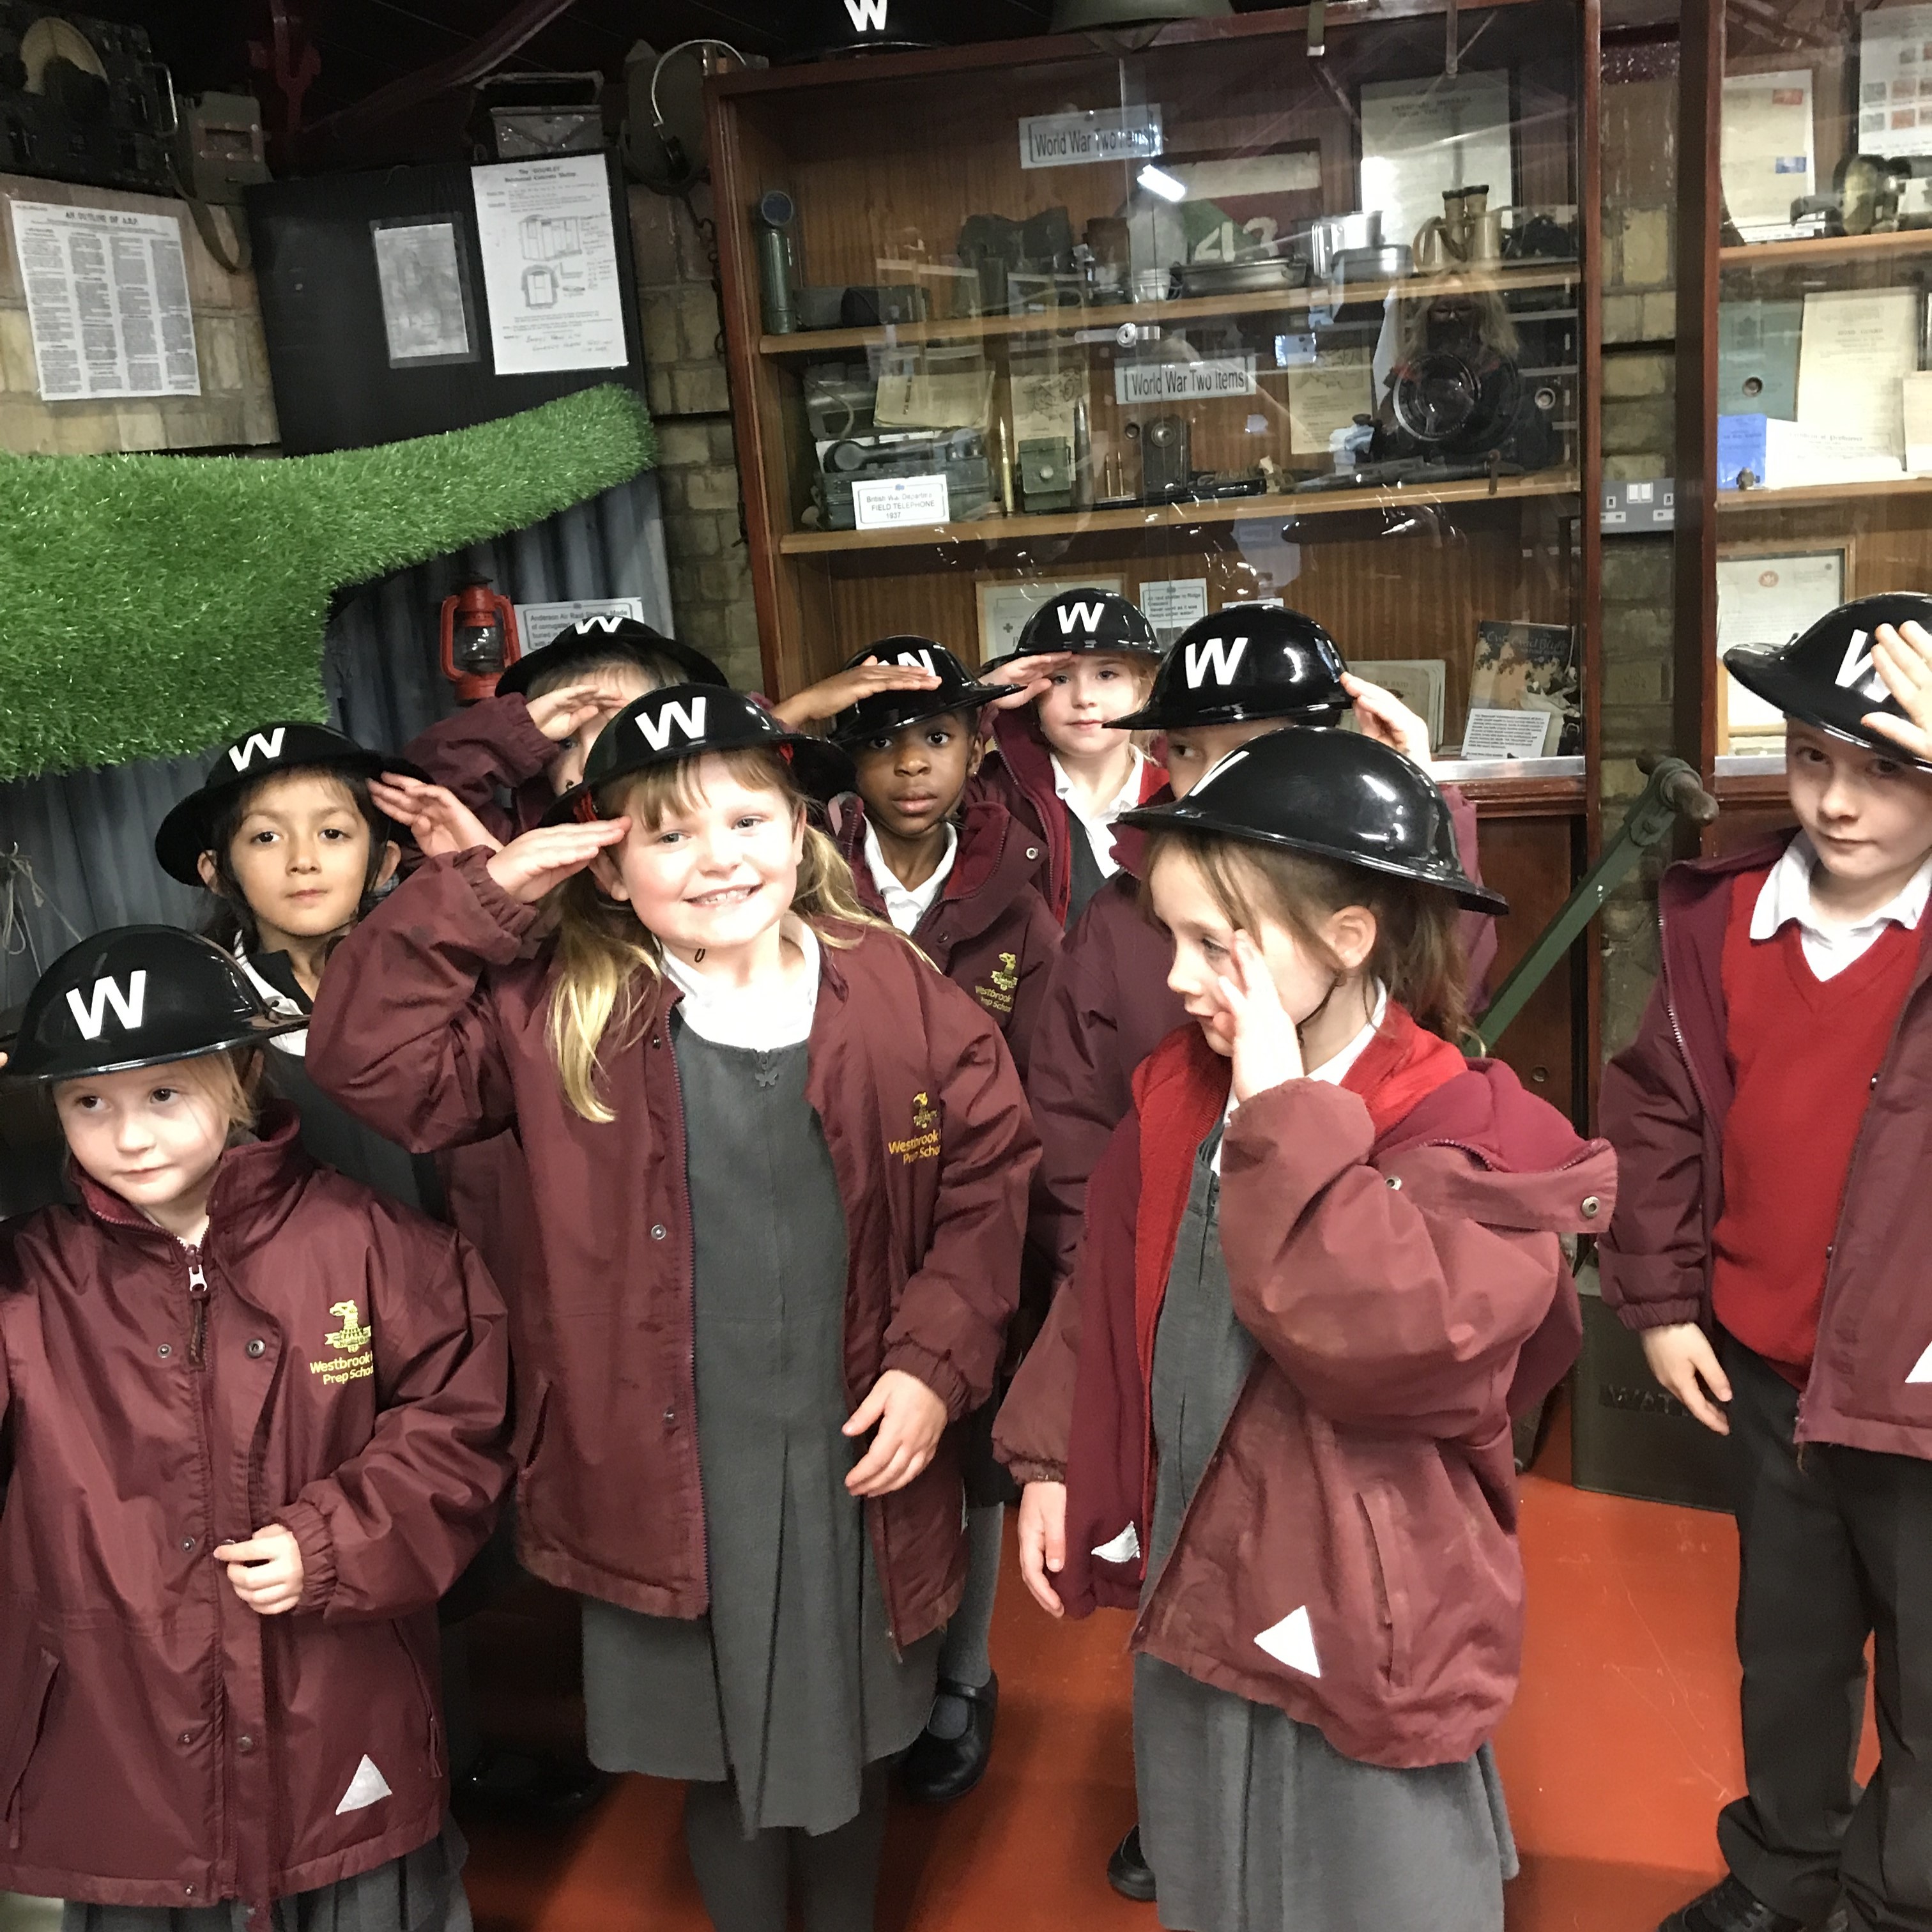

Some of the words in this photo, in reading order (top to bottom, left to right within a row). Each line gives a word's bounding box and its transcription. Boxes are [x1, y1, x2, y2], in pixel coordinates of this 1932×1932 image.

[845, 0, 886, 31] W
[1034, 133, 1066, 157] World
[1069, 129, 1091, 153] War
[1094, 128, 1116, 151] Two
[1131, 372, 1162, 395] World
[1165, 370, 1187, 393] War
[1190, 369, 1211, 391] Two
[1215, 371, 1245, 389] Items
[894, 500, 935, 510] TELEPHONE
[576, 615, 624, 634] W
[1057, 602, 1104, 633] W
[1185, 638, 1248, 688] W
[635, 697, 706, 751] W
[229, 728, 286, 772] W
[66, 970, 146, 1040] W
[309, 1352, 371, 1374] Westbrook
[323, 1372, 349, 1385] Prep
[349, 1363, 374, 1380] Schoo
[1608, 1384, 1688, 1417] WAT
